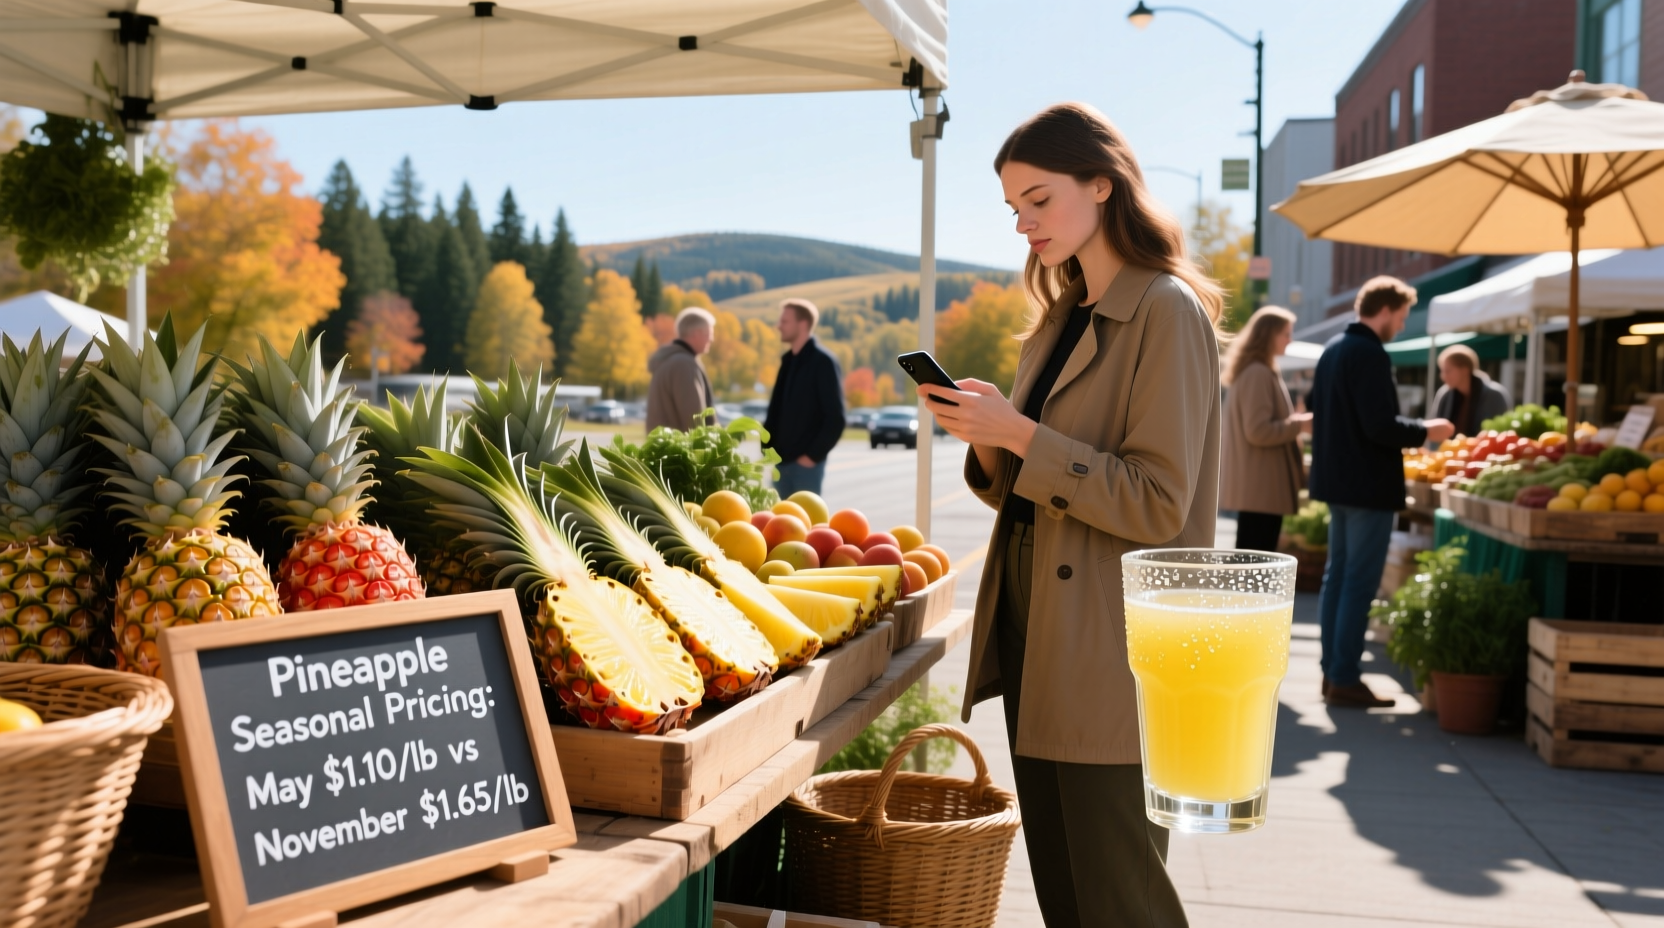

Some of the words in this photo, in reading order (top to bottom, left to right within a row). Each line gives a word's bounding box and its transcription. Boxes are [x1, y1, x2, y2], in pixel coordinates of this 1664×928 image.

[268, 637, 448, 697] Pineapple
[231, 696, 374, 752] Seasonal
[386, 685, 495, 724] Pricing:
[246, 772, 313, 809] May
[323, 740, 438, 796] $1.10/lb
[448, 739, 479, 765] vs
[254, 805, 408, 865] November
[420, 773, 529, 829] $1.65/lb
